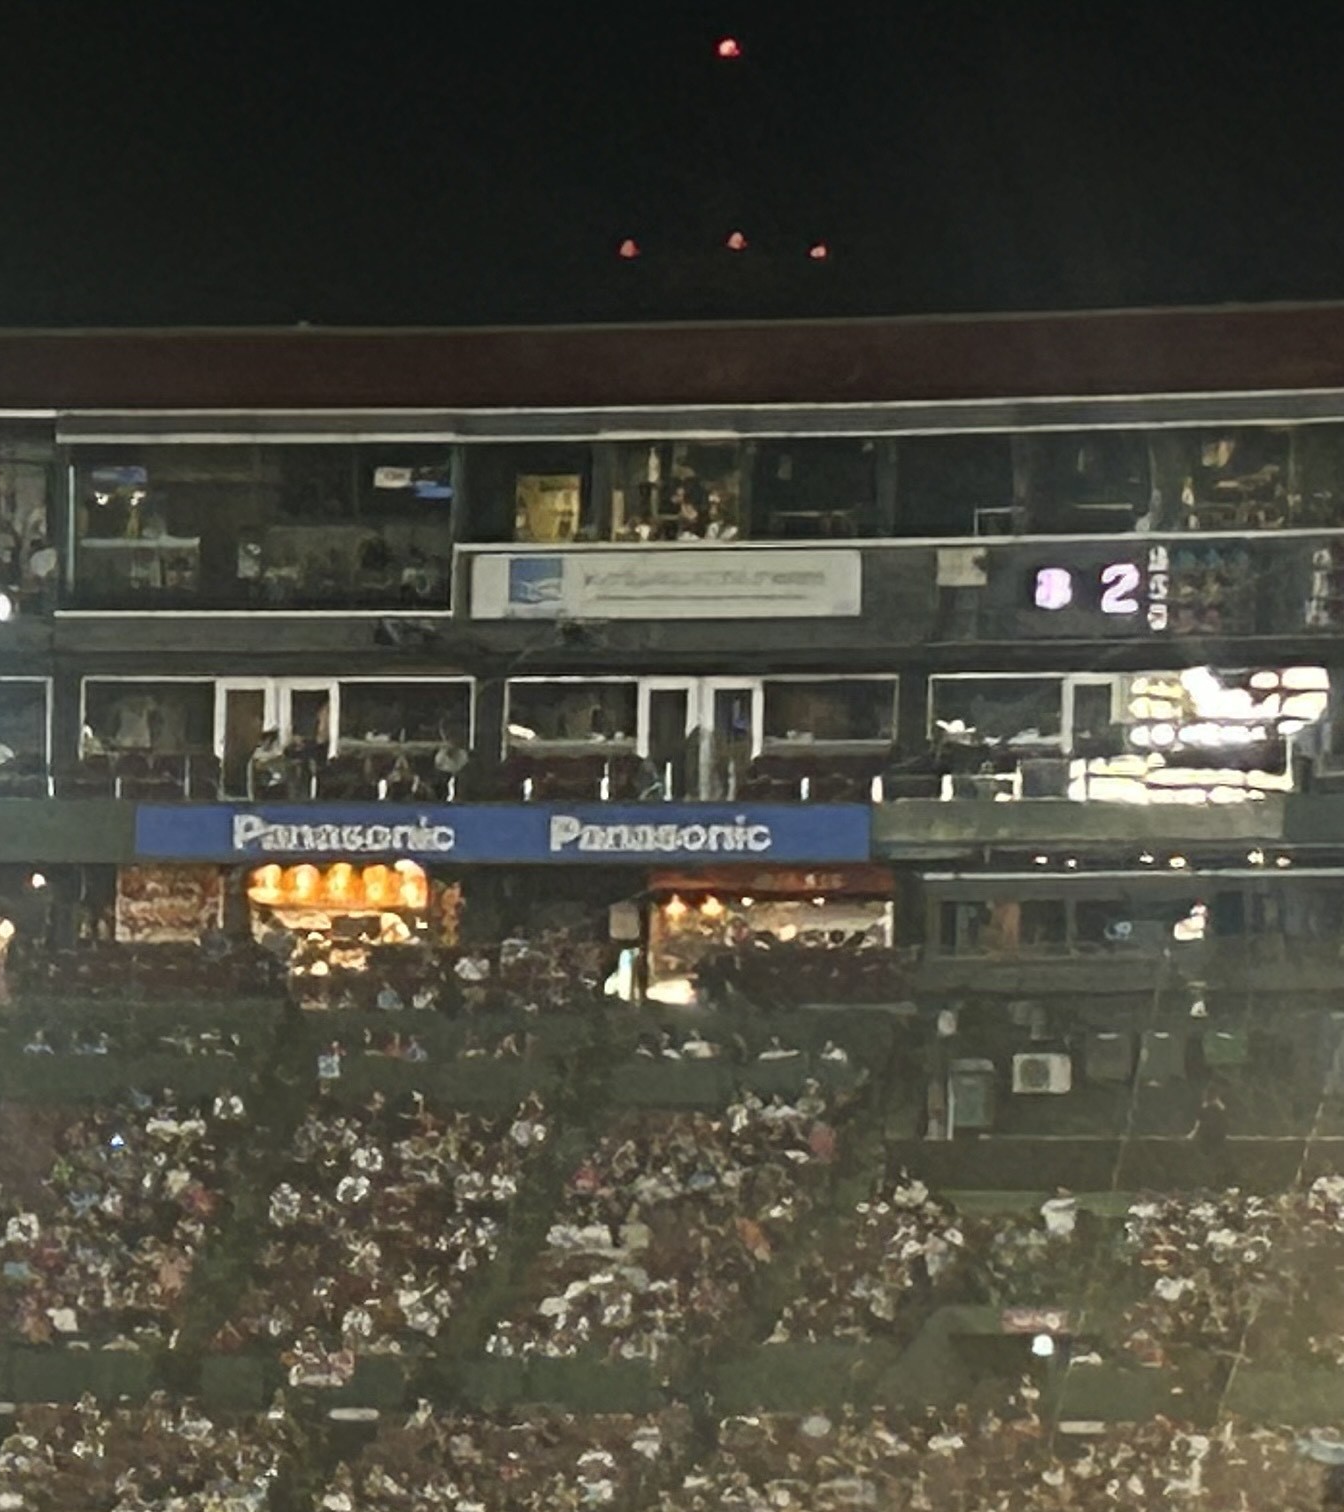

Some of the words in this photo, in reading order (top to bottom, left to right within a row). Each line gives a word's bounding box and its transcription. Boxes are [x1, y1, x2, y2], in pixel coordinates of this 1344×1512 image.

[1101, 563, 1140, 613] 2
[233, 812, 455, 852] Panasonic
[550, 813, 773, 852] Panasonic
